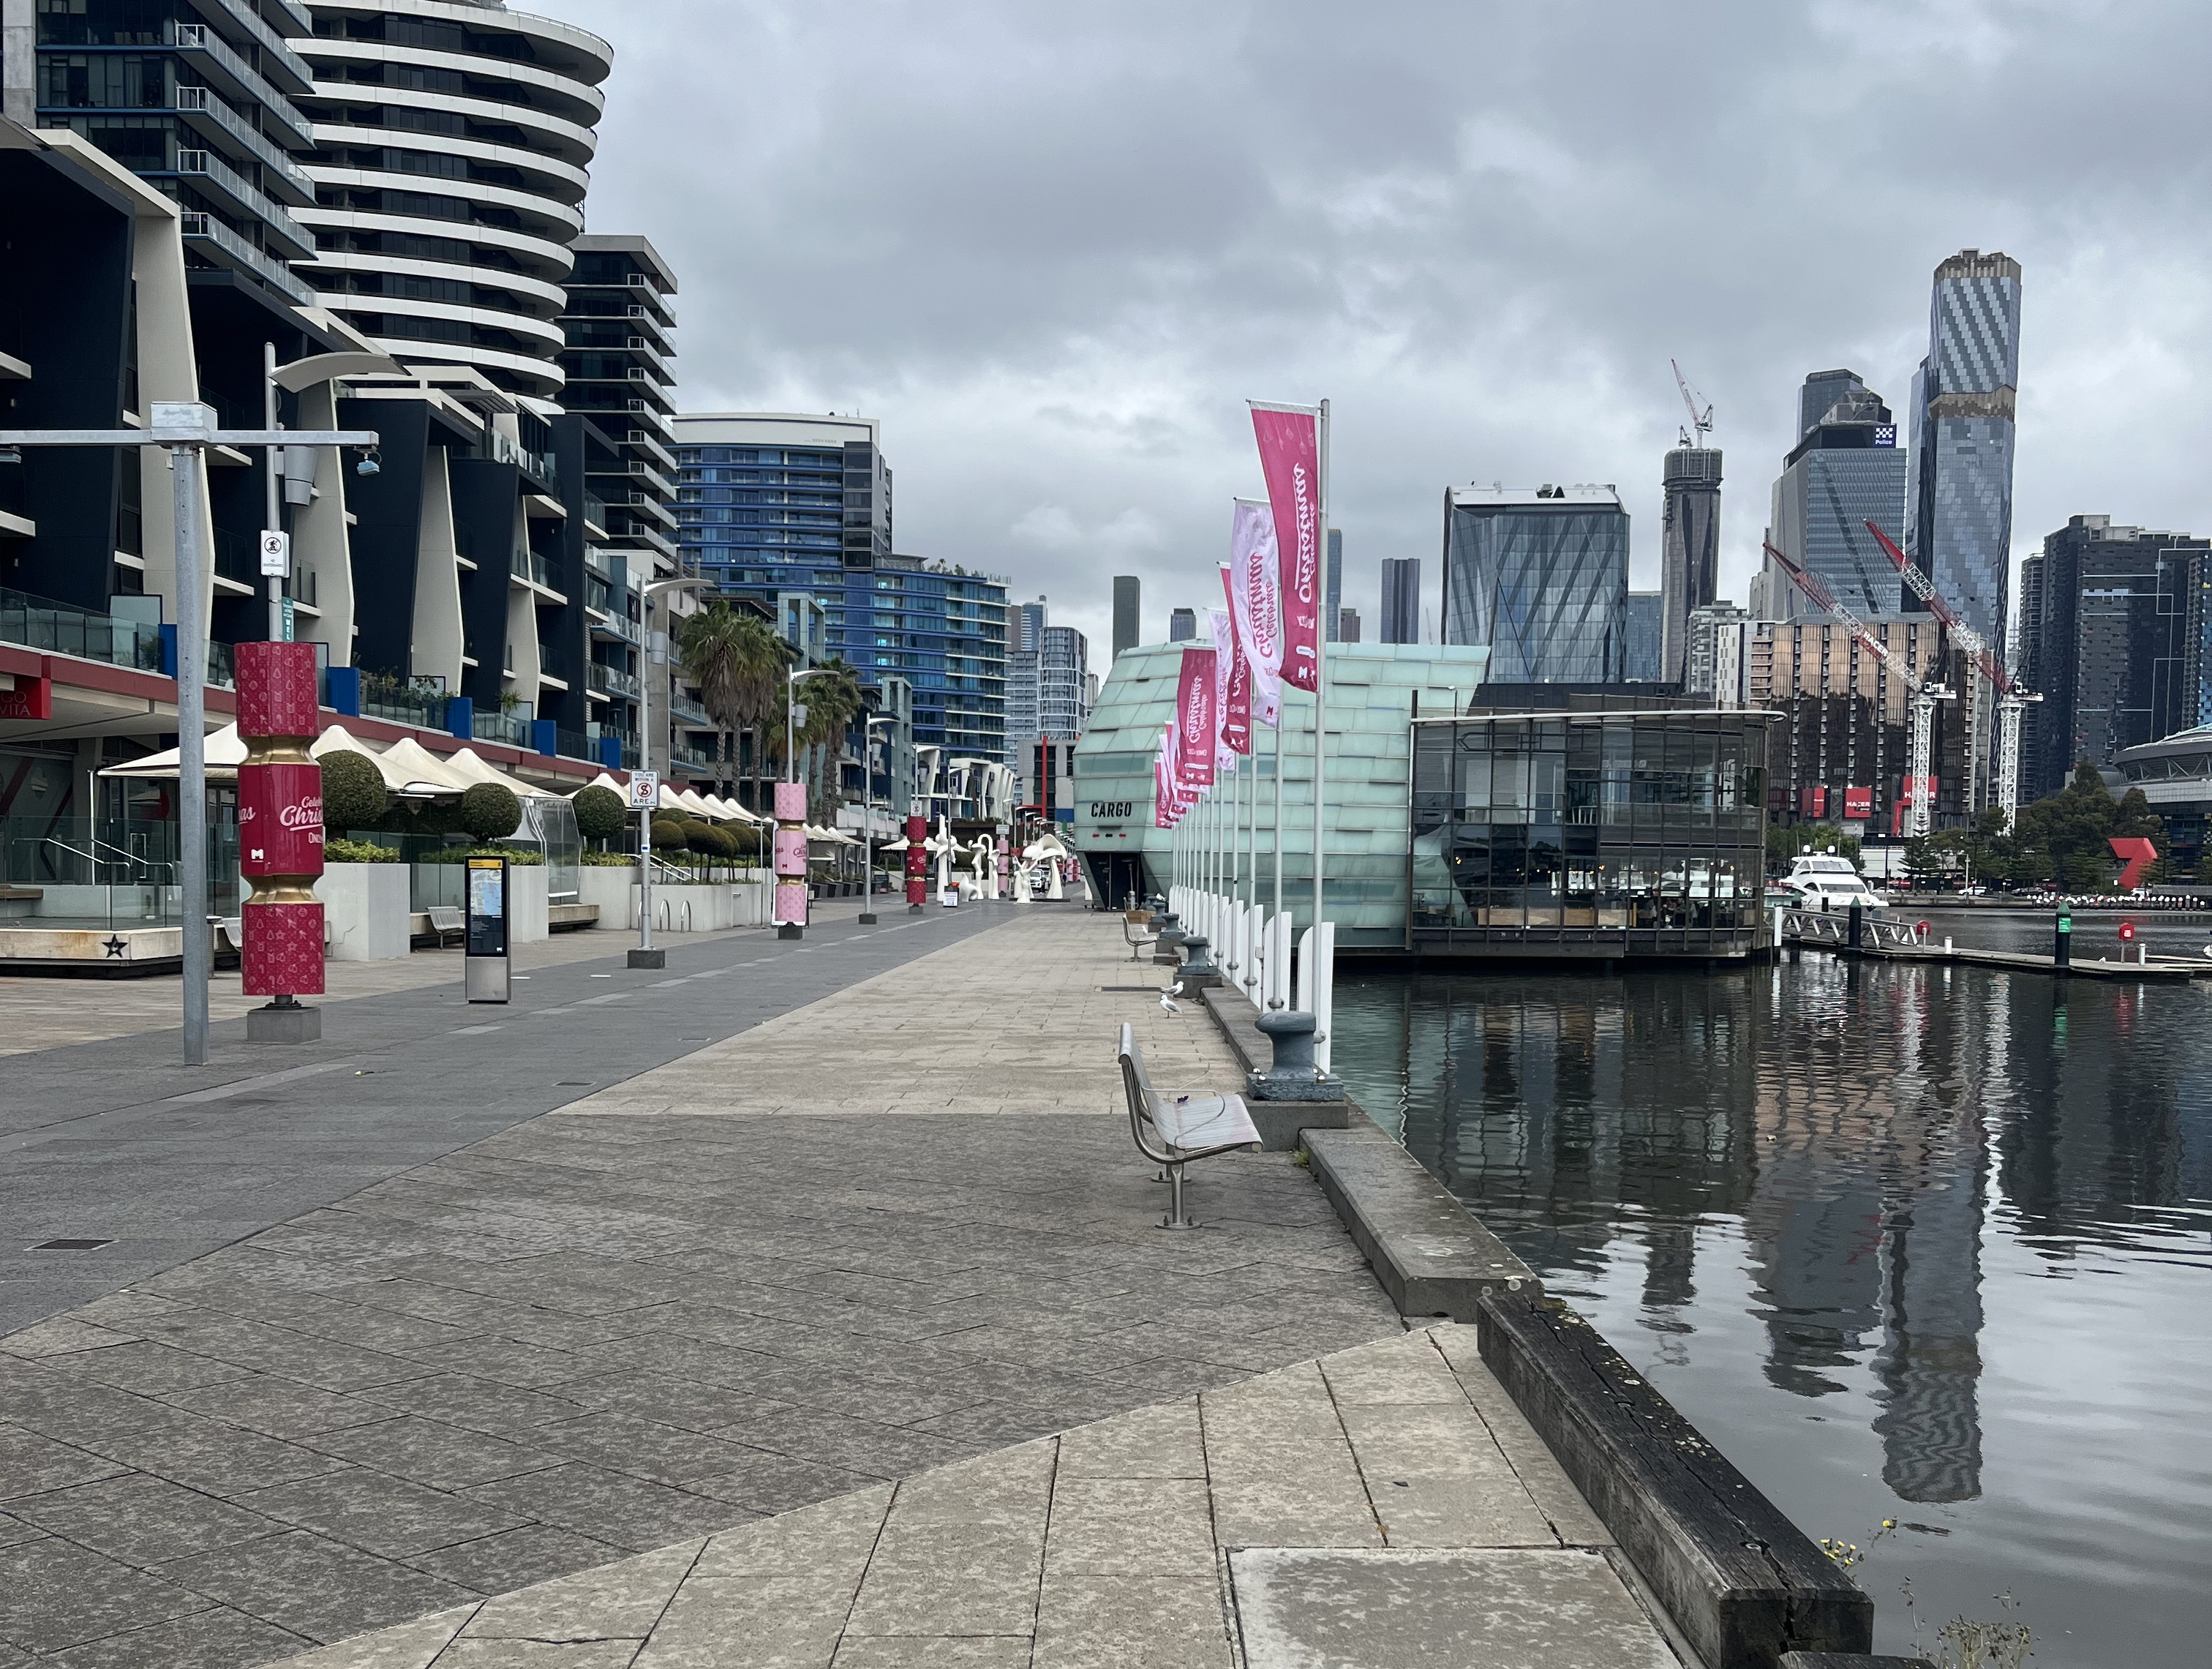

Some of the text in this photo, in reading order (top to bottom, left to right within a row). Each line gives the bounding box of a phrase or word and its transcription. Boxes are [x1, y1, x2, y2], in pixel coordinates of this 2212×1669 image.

[1863, 630, 1889, 658] HACER
[1957, 622, 1983, 653] HACER
[0, 703, 31, 716] VITA
[1091, 802, 1132, 818] CARGO
